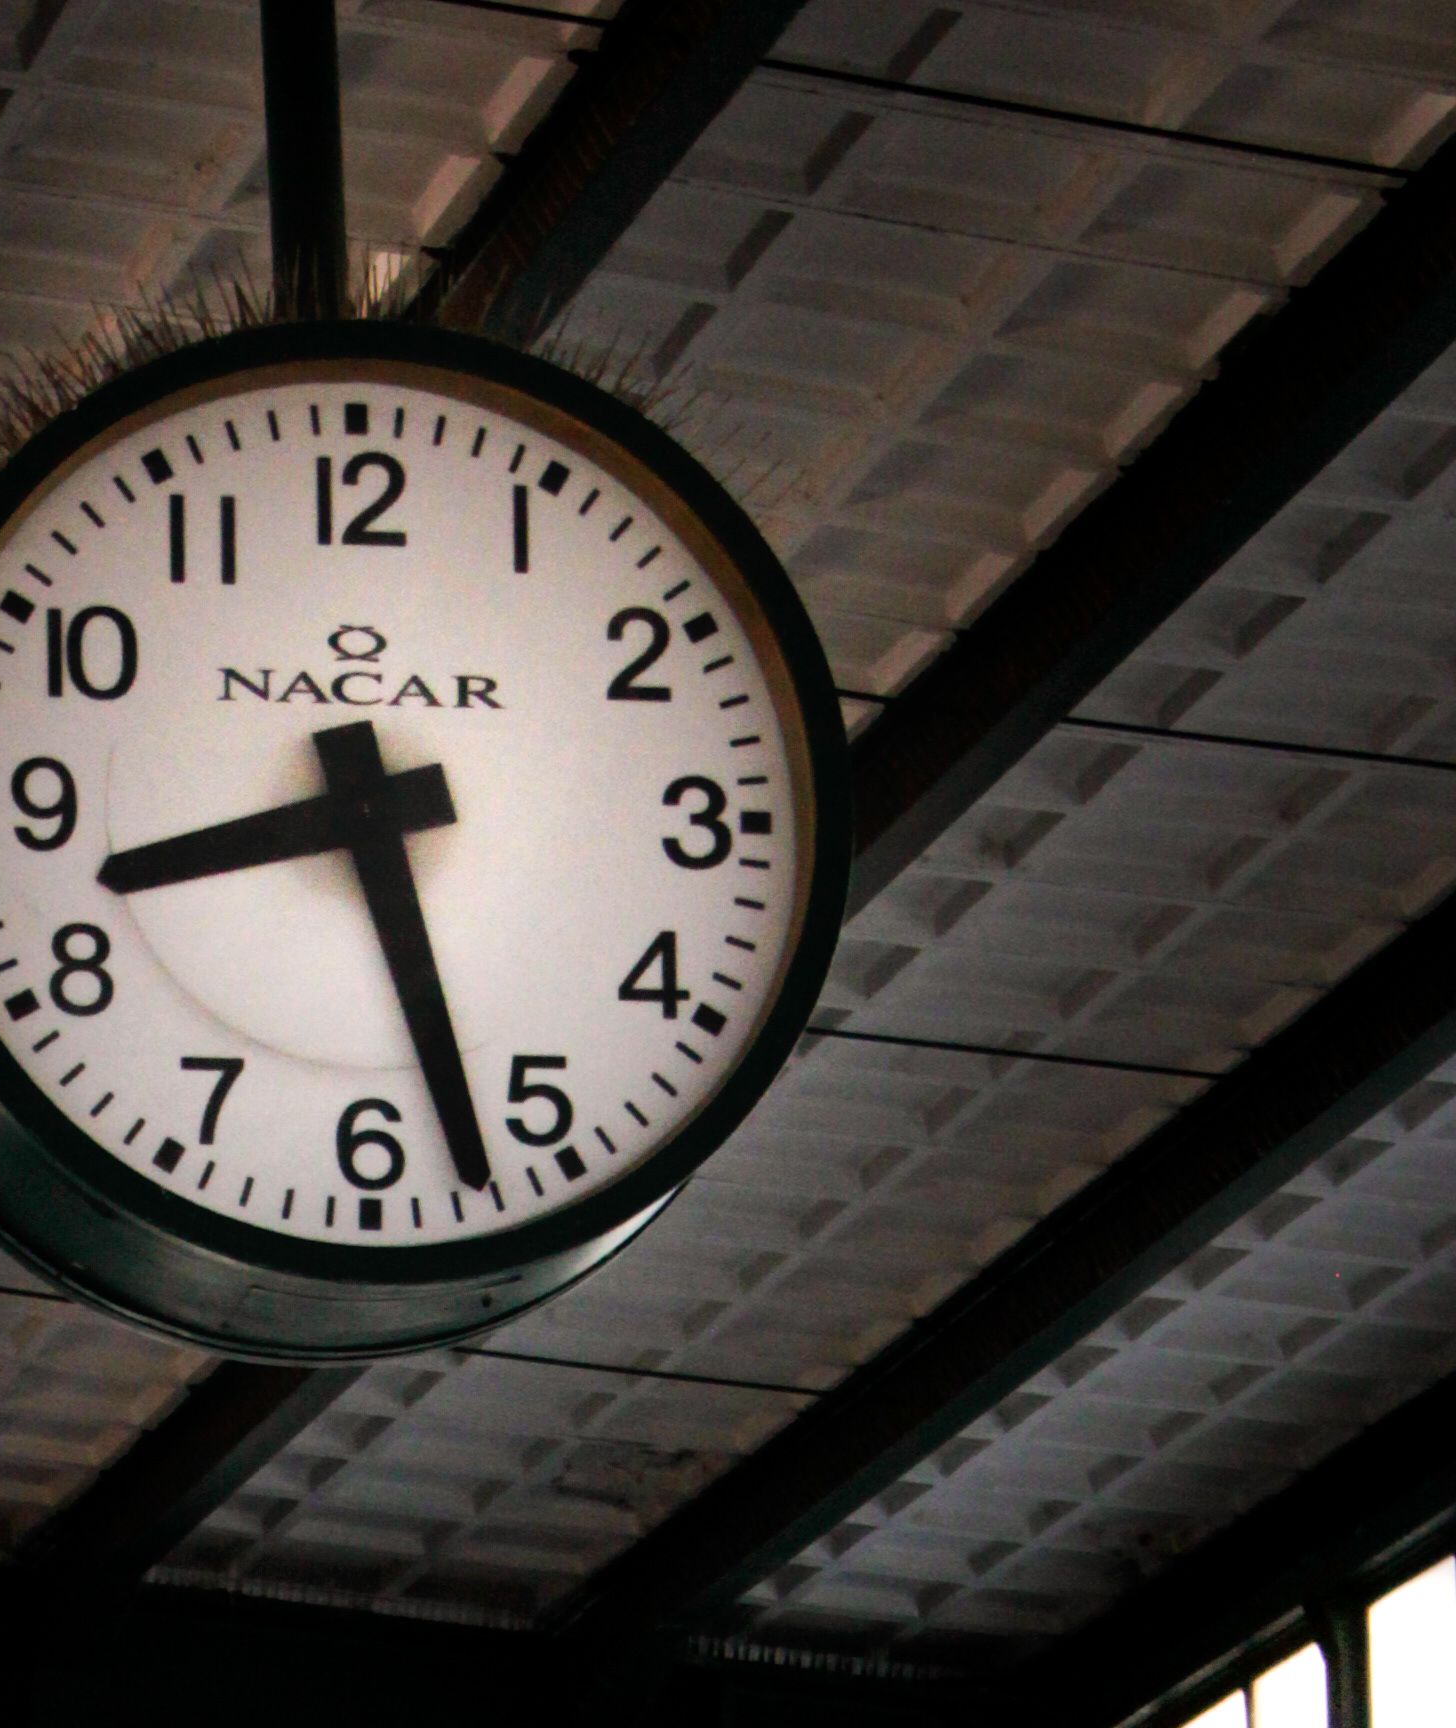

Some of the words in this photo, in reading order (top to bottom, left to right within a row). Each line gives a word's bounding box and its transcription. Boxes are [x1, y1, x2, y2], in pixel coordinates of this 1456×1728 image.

[168, 494, 236, 584] 11
[316, 451, 406, 547] 12
[512, 484, 528, 574] 1
[47, 605, 137, 700] 10
[218, 667, 506, 708] NACAR
[607, 606, 671, 702] 2
[11, 757, 77, 851] 9
[662, 775, 732, 870] 3
[49, 923, 113, 1016] 8
[619, 930, 691, 1019] 4
[179, 1056, 245, 1145] 7
[336, 1098, 405, 1191] 6
[506, 1055, 575, 1146] 5
